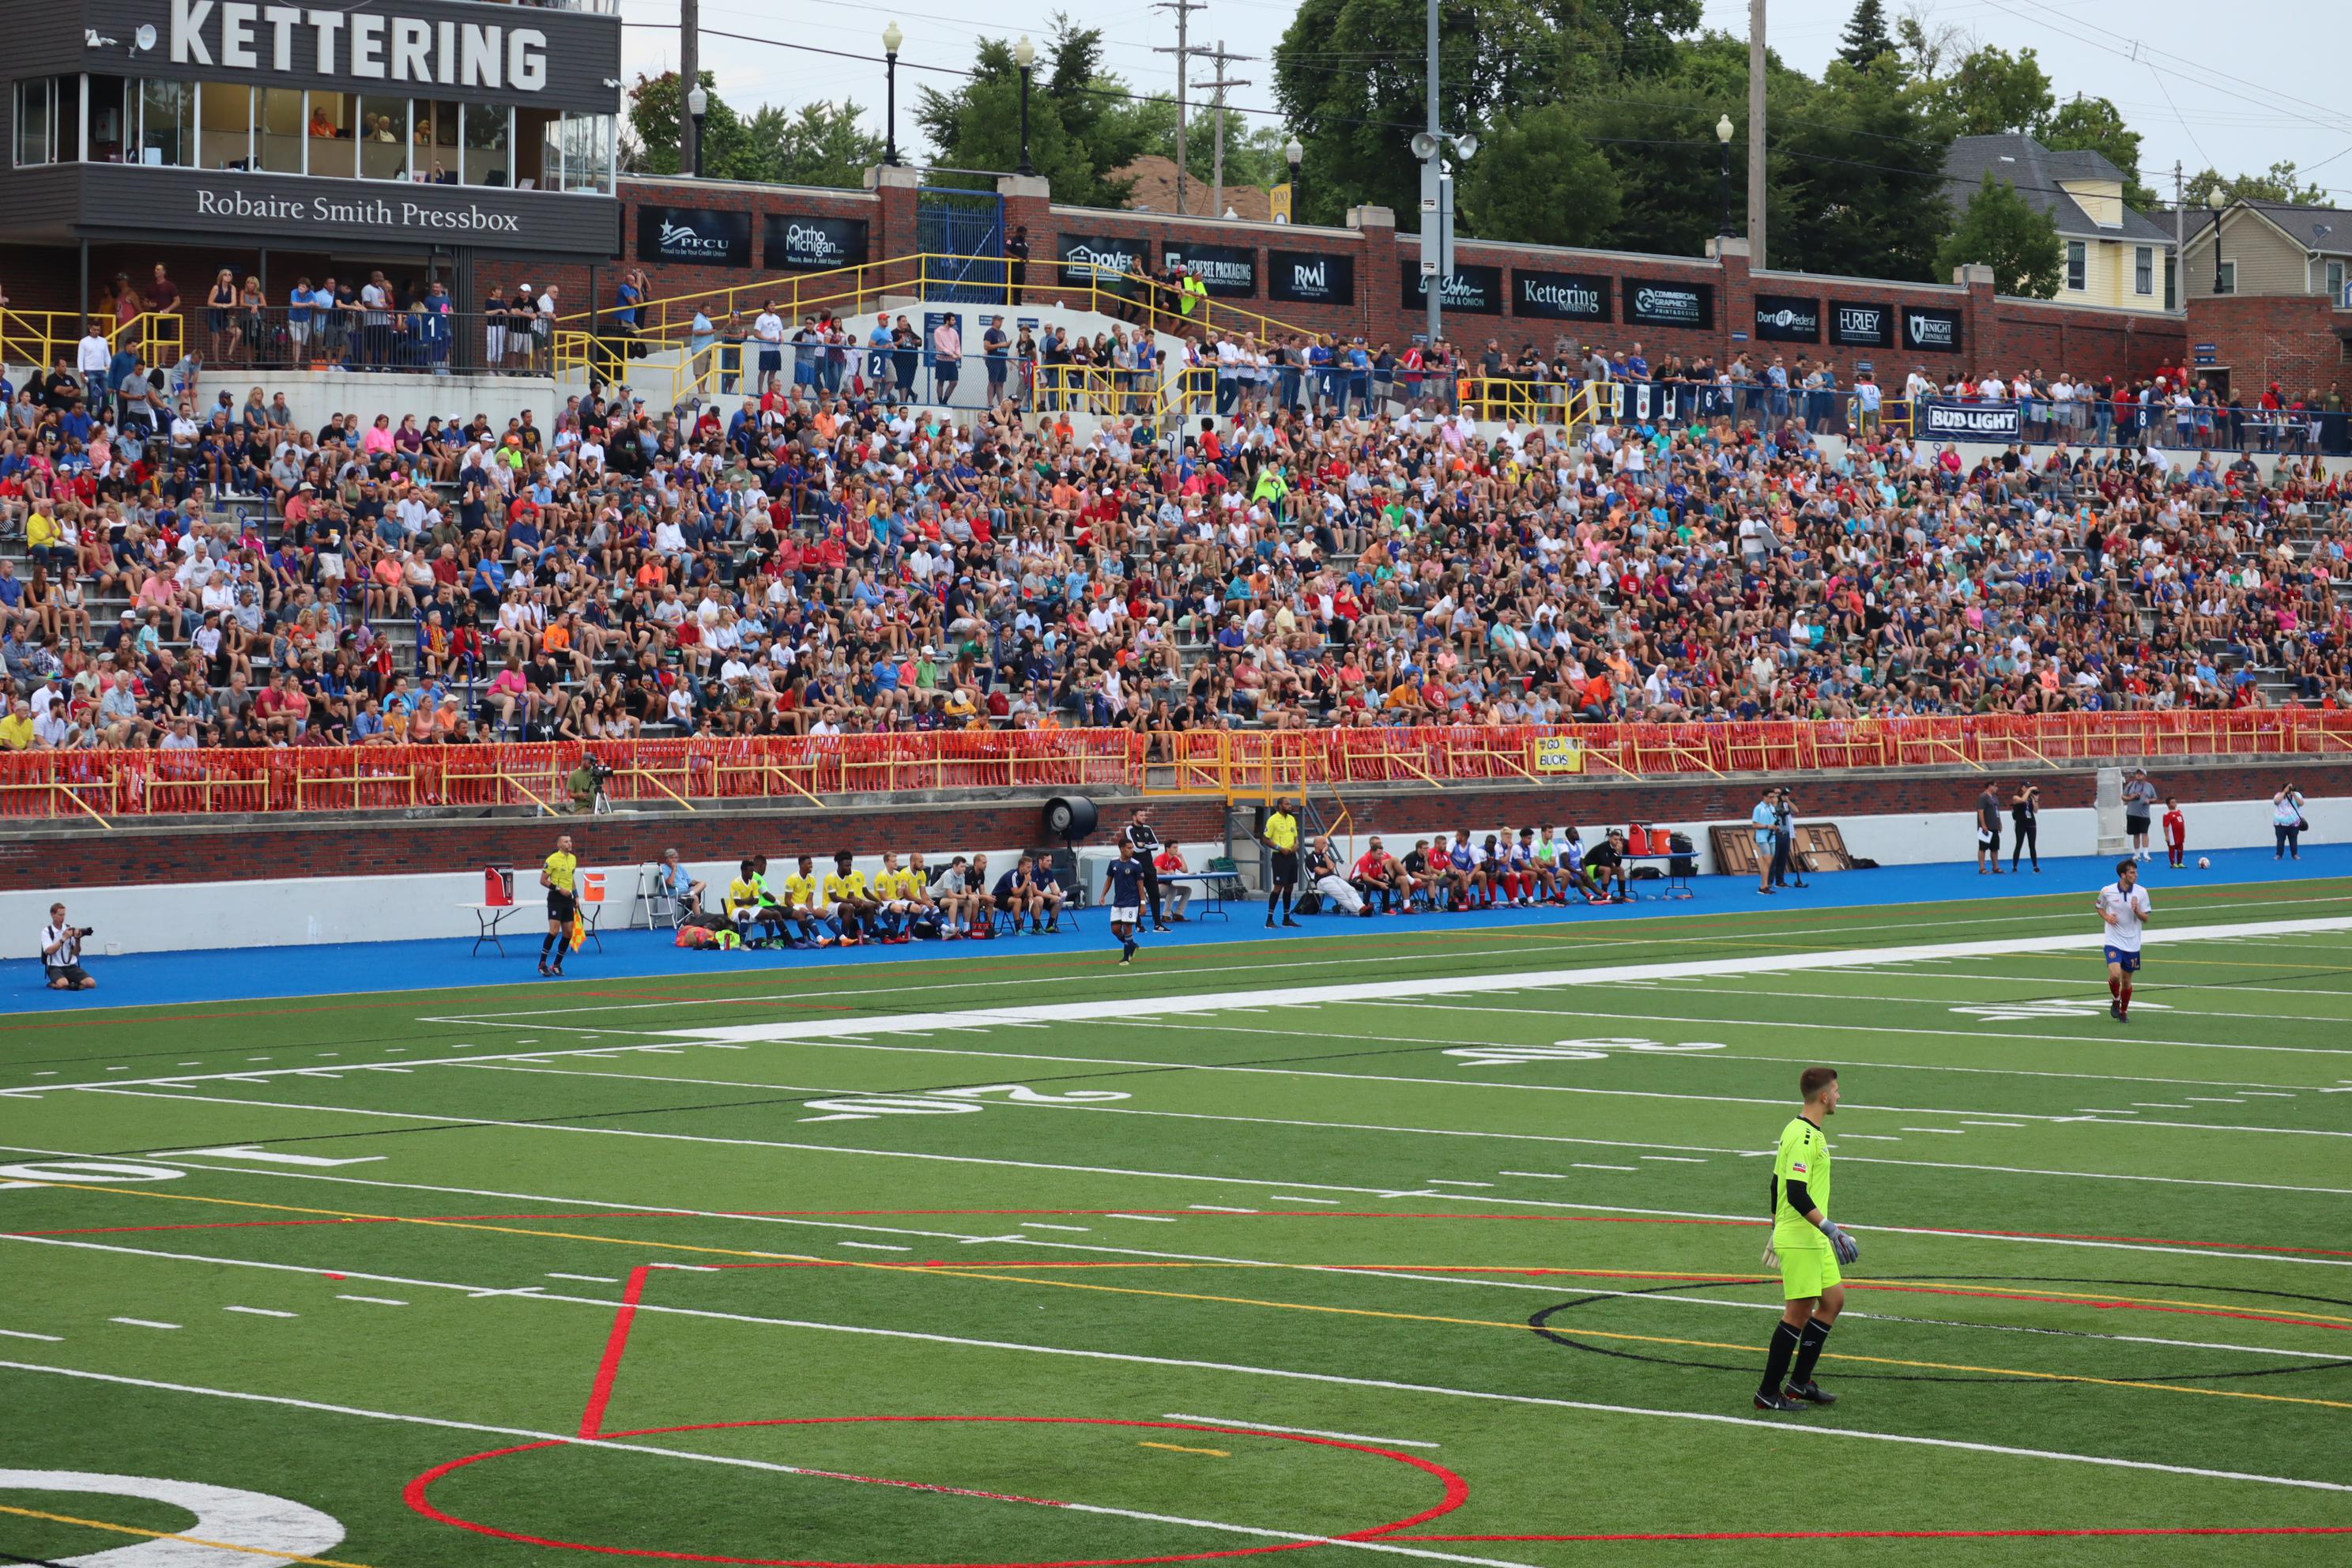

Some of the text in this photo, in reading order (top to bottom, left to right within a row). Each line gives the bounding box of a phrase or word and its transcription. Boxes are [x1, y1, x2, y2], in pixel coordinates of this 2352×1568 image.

[170, 0, 547, 92] KETTERING
[196, 189, 519, 232] Robaire Smith Pressbox
[789, 224, 826, 242] Ortho
[681, 237, 729, 249] PFCU
[1216, 261, 1251, 280] PACKAGING
[1440, 296, 1484, 307] TEAK & ONION
[1524, 280, 1599, 313] Kettering
[1654, 290, 1698, 300] COMMERCIAL
[1654, 299, 1687, 307] GRAPHICS
[1558, 303, 1589, 312] UNIVERSITY
[428, 316, 435, 337] 1
[1757, 311, 1776, 323] Dort
[1792, 314, 1816, 326] Federal
[1840, 311, 1880, 331] HURLEY
[1924, 322, 1951, 334] KNIGHT
[873, 356, 881, 370] 2
[1323, 375, 1331, 393] 4
[1706, 391, 1713, 408] 6
[1932, 409, 2015, 429] BUD LIGHT
[2139, 410, 2147, 426] 8
[1547, 739, 1560, 749] GO
